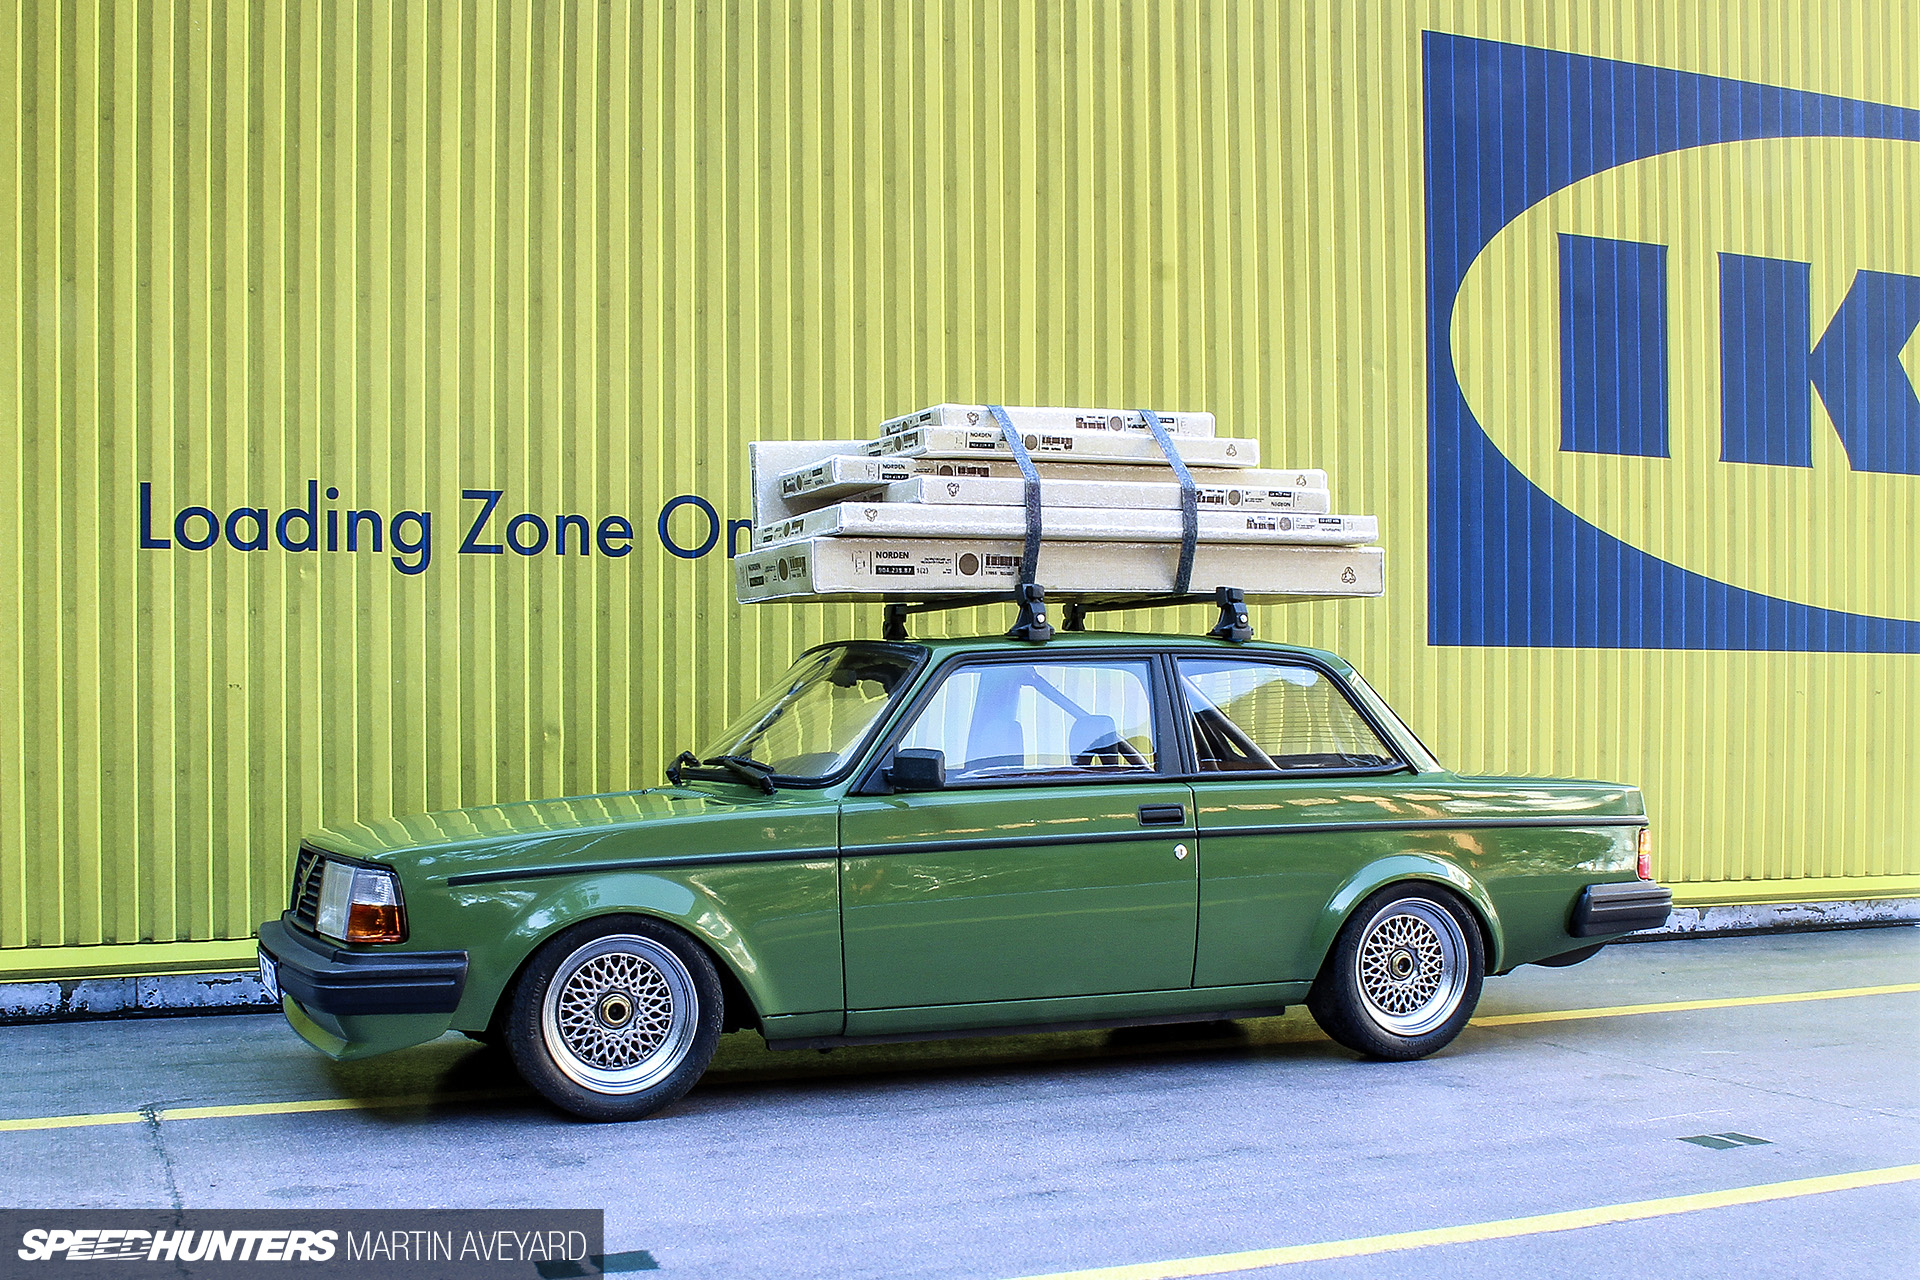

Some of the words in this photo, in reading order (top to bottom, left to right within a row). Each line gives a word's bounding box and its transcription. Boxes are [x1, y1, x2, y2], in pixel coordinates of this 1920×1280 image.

[1558, 232, 1920, 476] IK
[140, 480, 431, 575] Loading
[459, 489, 633, 557] Zone
[876, 551, 910, 559] NORDEN
